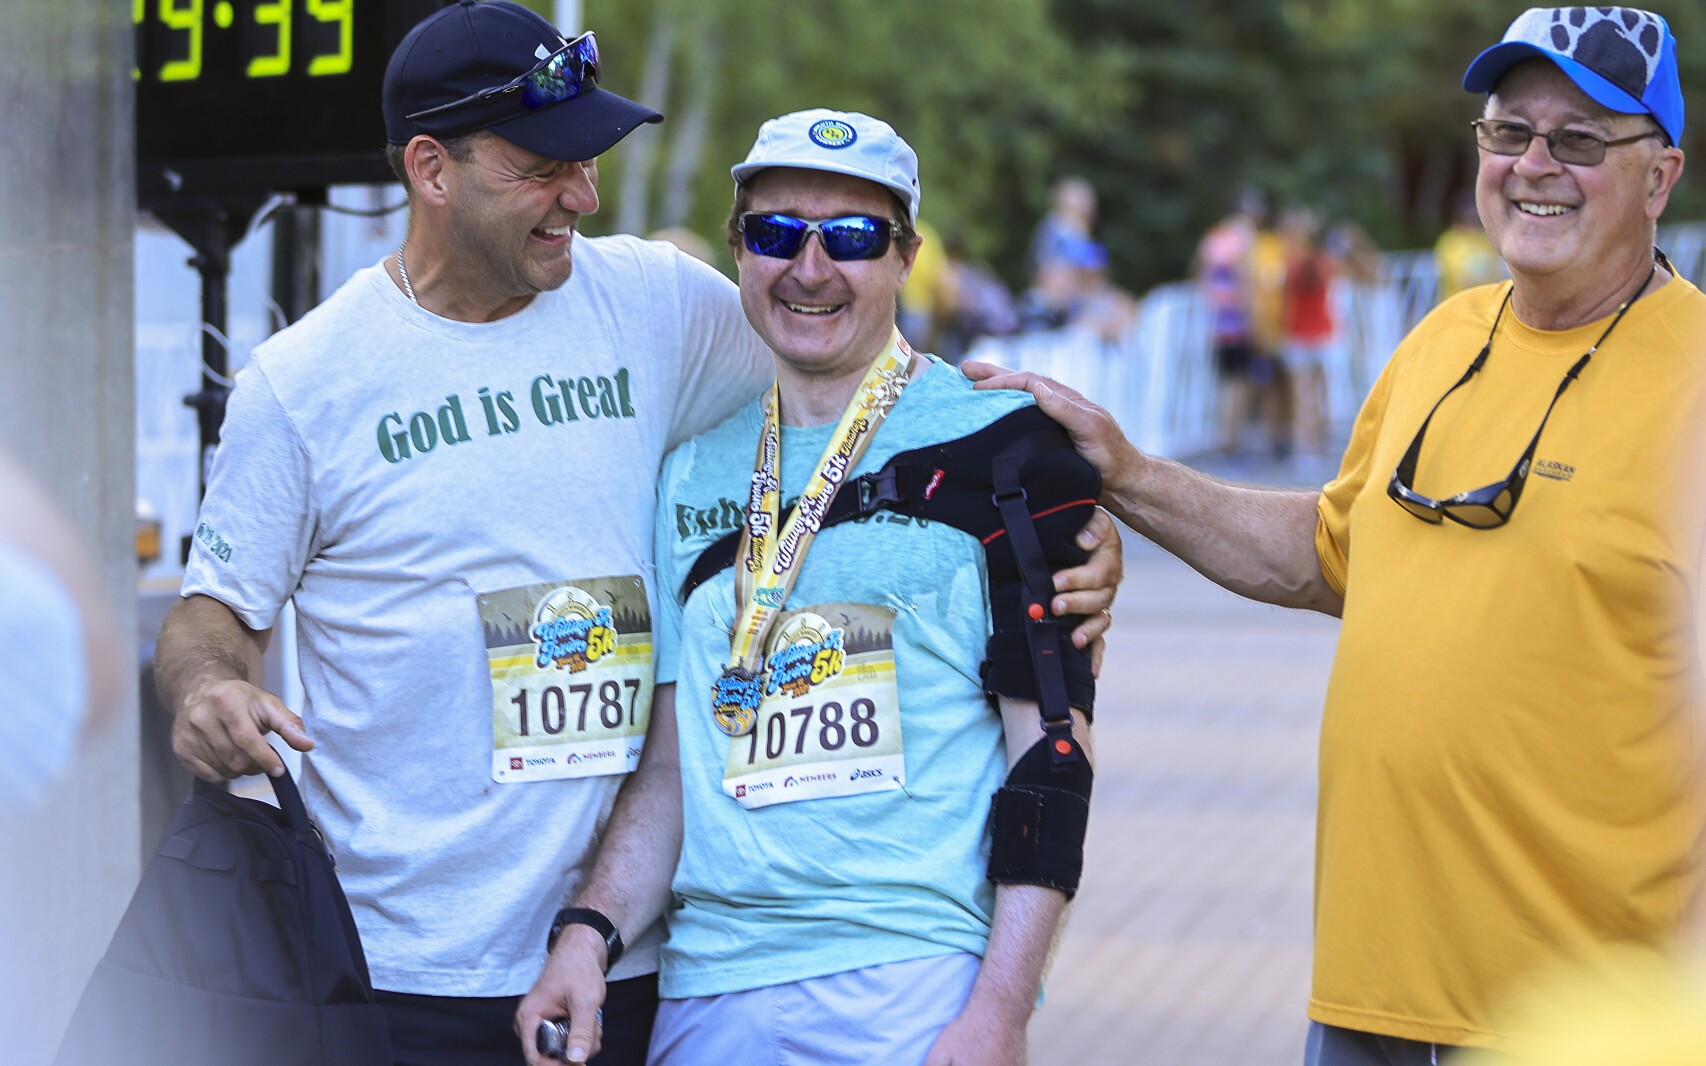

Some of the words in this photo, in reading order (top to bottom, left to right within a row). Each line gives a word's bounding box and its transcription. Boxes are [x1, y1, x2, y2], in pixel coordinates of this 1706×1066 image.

[377, 394, 472, 464] God
[477, 387, 521, 435] is
[531, 367, 635, 427] Great
[511, 678, 640, 737] 10787
[748, 698, 879, 765] 10788
